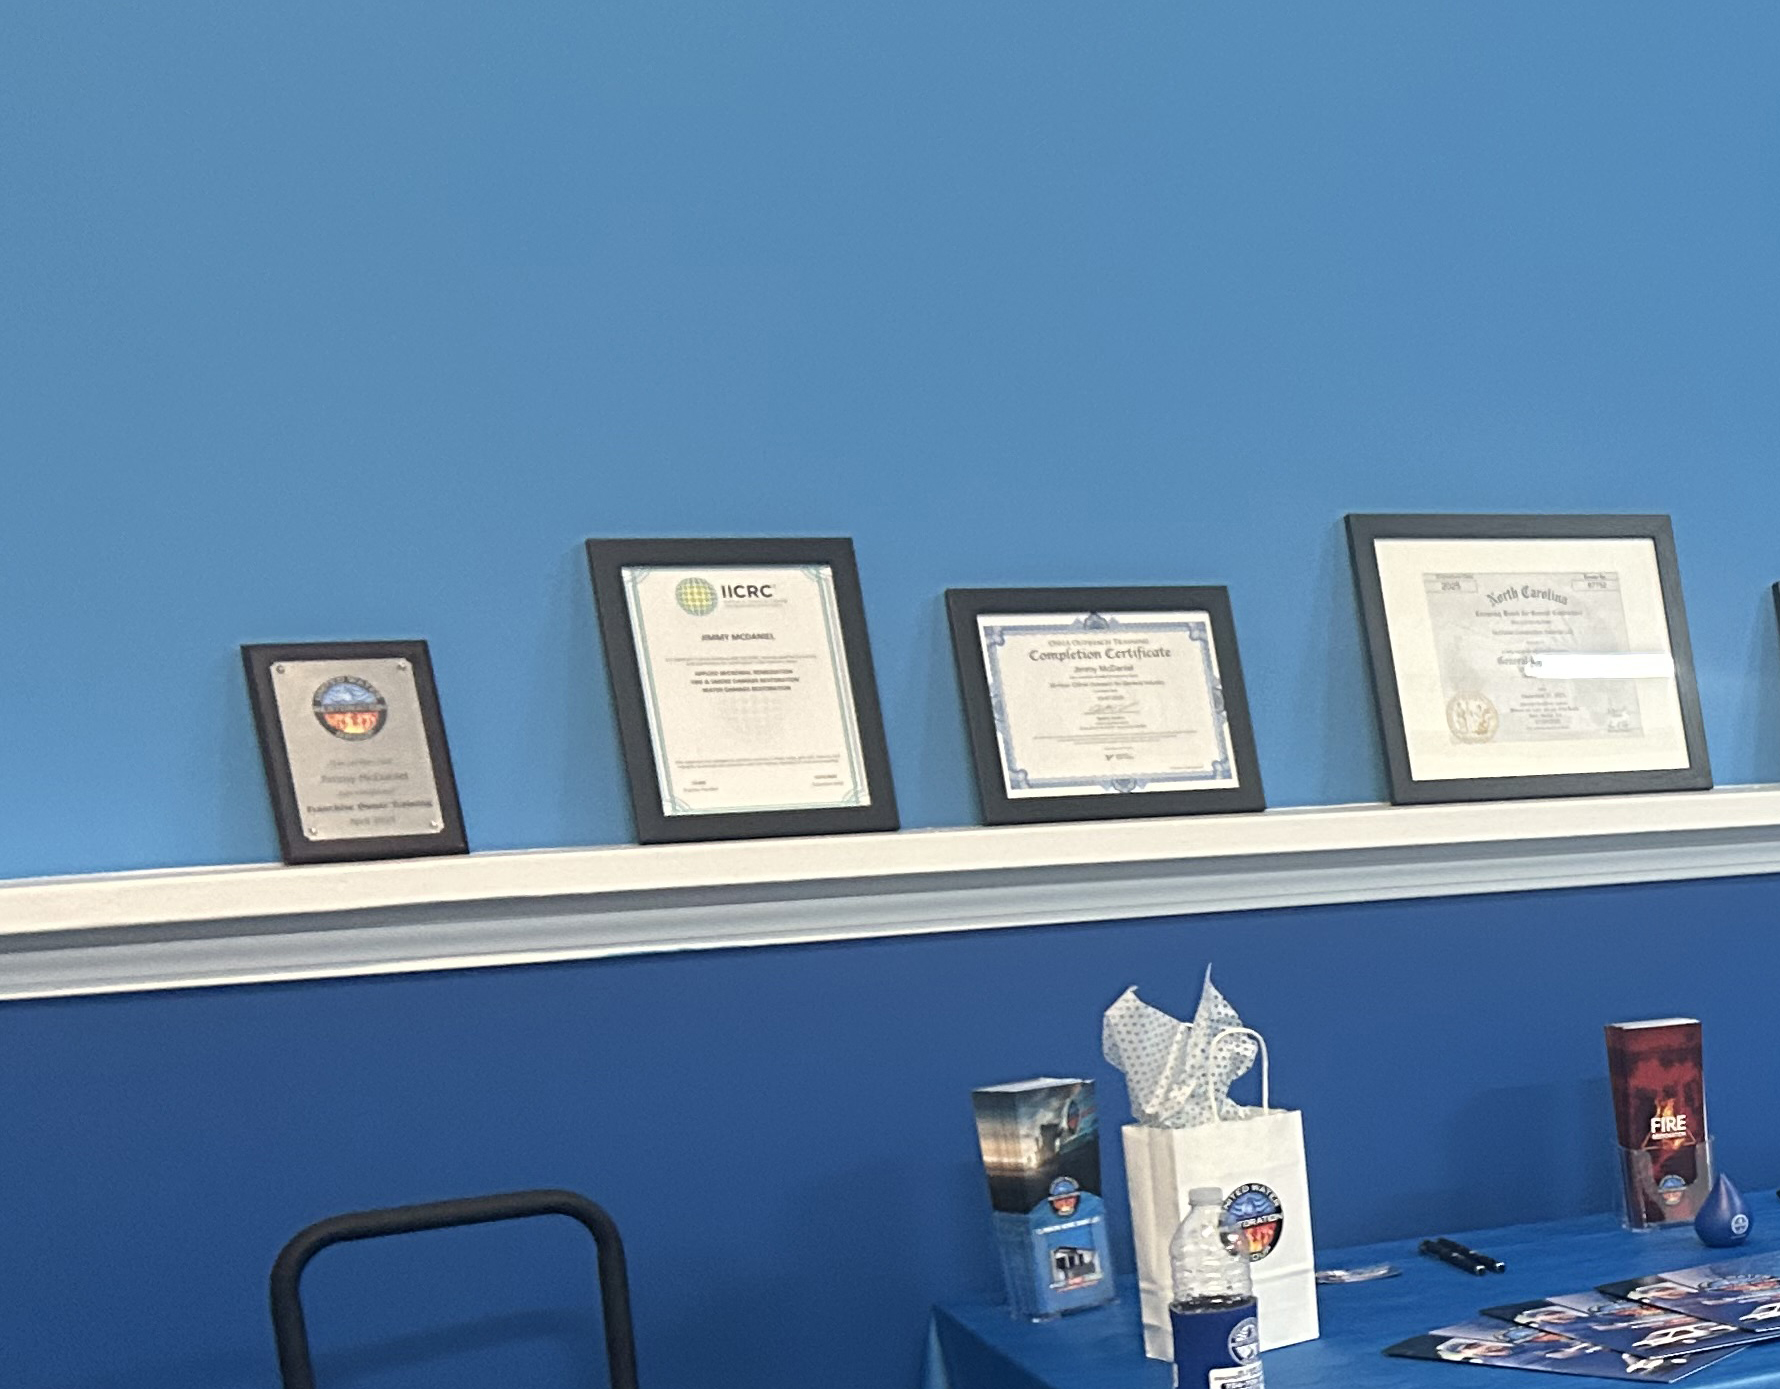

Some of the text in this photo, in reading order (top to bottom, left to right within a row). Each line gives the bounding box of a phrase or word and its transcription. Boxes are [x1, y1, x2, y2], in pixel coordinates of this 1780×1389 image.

[721, 584, 773, 599] IICRC
[1486, 585, 1569, 607] North Carolina
[1028, 646, 1172, 661] Completion Certificate
[1650, 1114, 1687, 1134] FIRE
